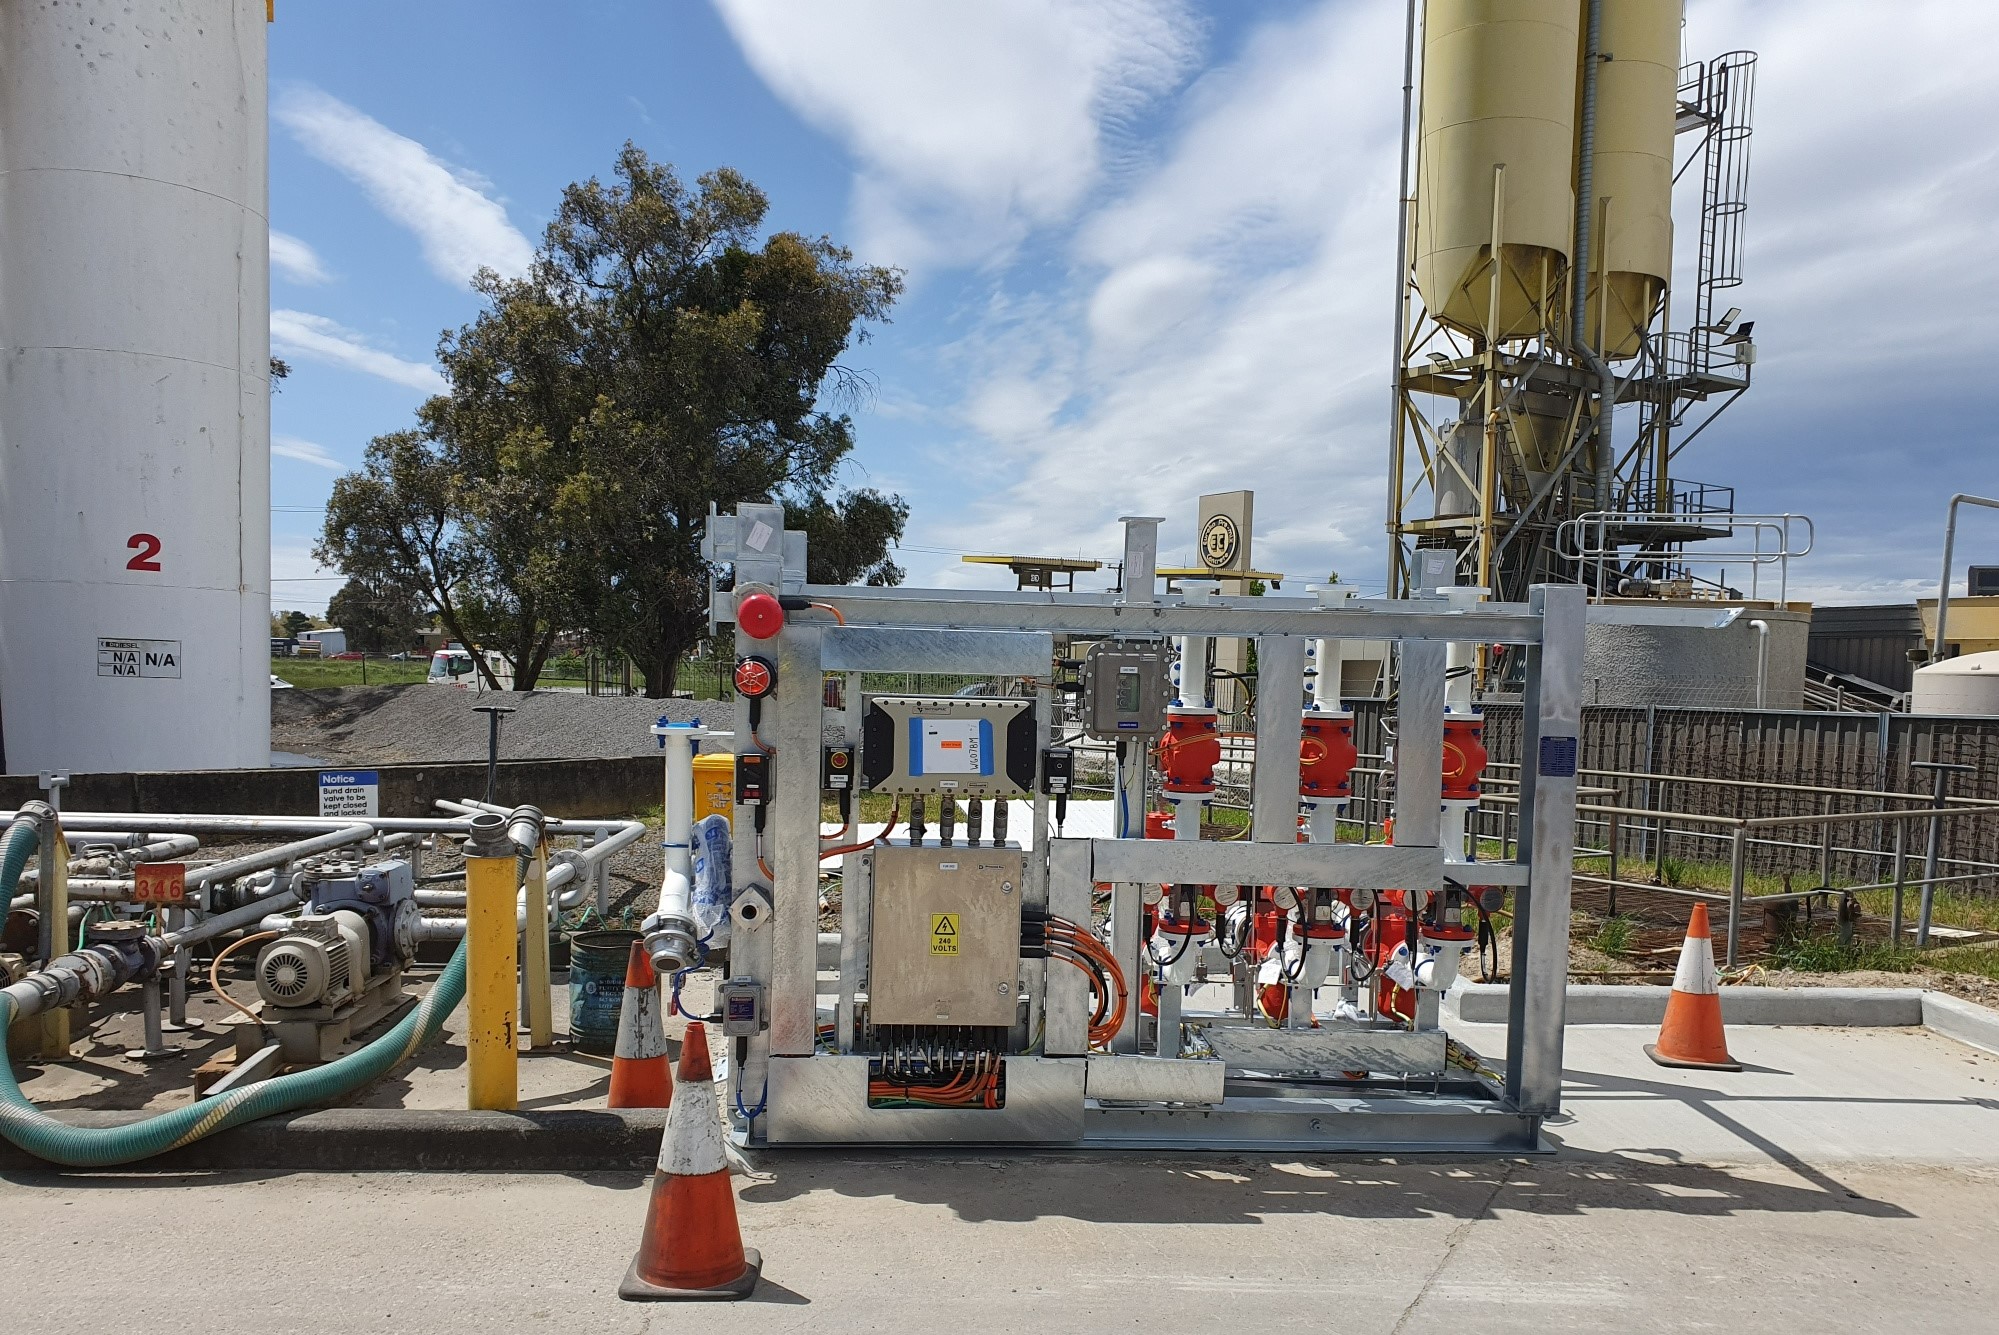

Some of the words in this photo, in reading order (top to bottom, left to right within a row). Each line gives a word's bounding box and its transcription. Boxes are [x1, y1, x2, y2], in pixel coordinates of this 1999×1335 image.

[126, 533, 161, 571] 2
[113, 652, 136, 664] N/A
[145, 652, 175, 667] N/A
[113, 665, 136, 676] N/A
[322, 774, 355, 784] Notice
[323, 787, 343, 795] Bund
[323, 802, 341, 810] kept
[342, 801, 367, 809] closed
[138, 879, 181, 899] 346
[938, 937, 952, 945] 240
